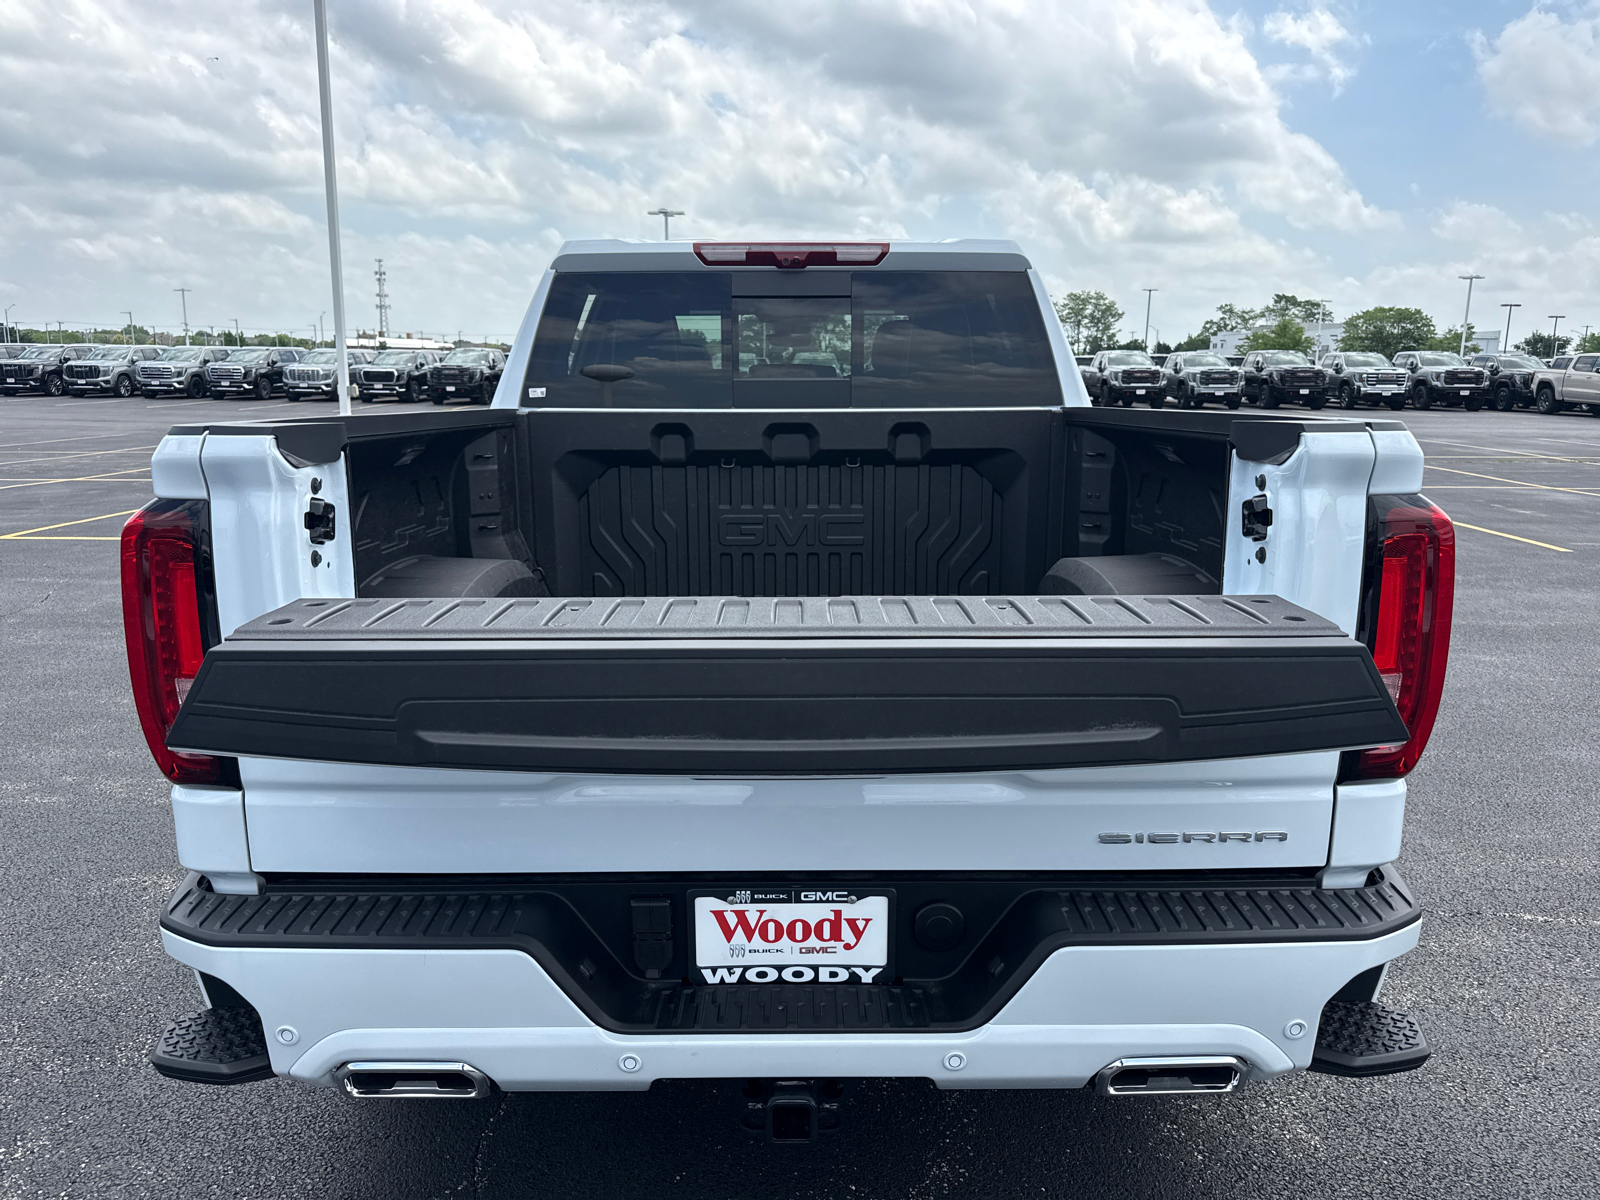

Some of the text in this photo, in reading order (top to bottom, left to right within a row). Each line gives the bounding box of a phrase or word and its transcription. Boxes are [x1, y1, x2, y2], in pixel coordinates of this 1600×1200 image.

[718, 514, 865, 547] GMC
[1098, 831, 1289, 845] SIERRA
[800, 891, 848, 901] GMC
[709, 909, 873, 951] Woody
[798, 946, 838, 955] GMC
[700, 966, 884, 984] WOODY
